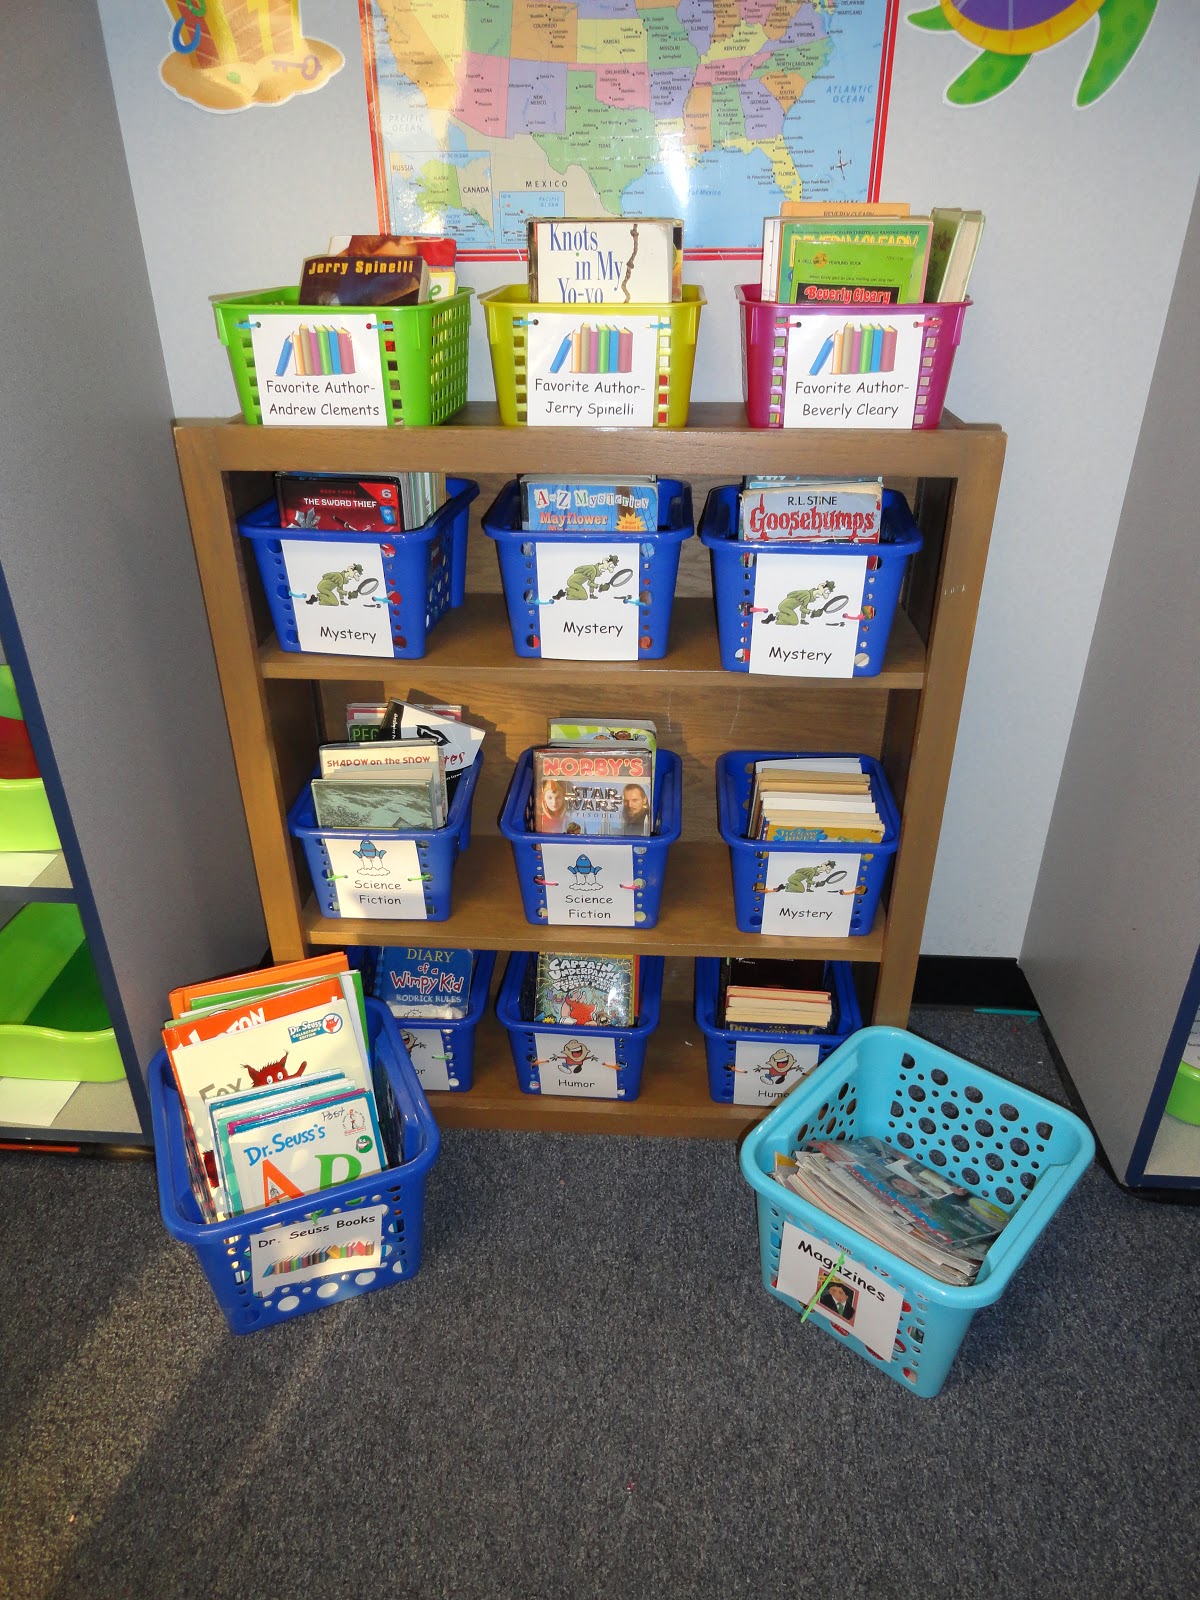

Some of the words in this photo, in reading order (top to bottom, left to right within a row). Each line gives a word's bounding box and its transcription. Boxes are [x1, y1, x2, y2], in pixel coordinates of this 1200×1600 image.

[826, 85, 873, 94] ATLANTIC
[832, 95, 865, 104] OCEAN
[525, 180, 568, 188] MEXICO
[550, 223, 599, 252] Knots
[308, 260, 349, 276] Jerry
[355, 260, 414, 276] Spinelli
[575, 252, 591, 281] in
[597, 251, 623, 291] My
[804, 285, 852, 304] Beverly
[852, 287, 891, 304] Cleary
[266, 380, 320, 394] Favorite
[324, 381, 376, 394] Author-
[535, 378, 590, 393] Favorite
[594, 381, 646, 394] Author-
[795, 381, 852, 394] Favorite
[855, 380, 910, 394] Author-
[269, 403, 316, 416] Andrew
[320, 403, 380, 416] Clements
[545, 401, 583, 417] Jerry
[587, 403, 634, 418] Spinelli
[802, 403, 852, 419] Beverly
[856, 402, 899, 418] Cleary
[303, 497, 321, 506] THE
[321, 498, 352, 508] SWORD
[352, 500, 378, 509] THIEF
[539, 512, 608, 527] Mayflower
[749, 495, 875, 536] Goosebumps
[320, 626, 377, 644] Mystery
[563, 621, 624, 637] Mystery
[768, 646, 832, 665] Mystery
[327, 758, 369, 768] SHADOW
[384, 757, 401, 765] the
[543, 757, 644, 777] NORBY'S
[565, 786, 622, 800] STAR
[565, 797, 623, 813] WARS
[354, 879, 402, 890] Science
[359, 894, 402, 905] Fiction
[565, 894, 614, 905] Science
[568, 909, 611, 919] Fiction
[779, 907, 833, 921] Mystery
[406, 948, 455, 963] DIARY
[418, 962, 430, 975] of
[548, 968, 620, 983] UNDERPANTS
[390, 970, 438, 995] Wimpy
[439, 972, 464, 994] Kid
[396, 994, 433, 1003] RODRICK
[434, 994, 462, 1003] RULES
[288, 1026, 302, 1036] Dr.
[301, 1021, 322, 1031] Seuss
[557, 1079, 595, 1089] Humor
[758, 1090, 791, 1099] Humo
[243, 1145, 273, 1167] Dr.
[270, 1123, 326, 1153] Seuss's
[258, 1238, 281, 1248] Dr.
[289, 1225, 330, 1240] Seuss
[336, 1214, 376, 1229] Books
[797, 1240, 886, 1302] Magazines
